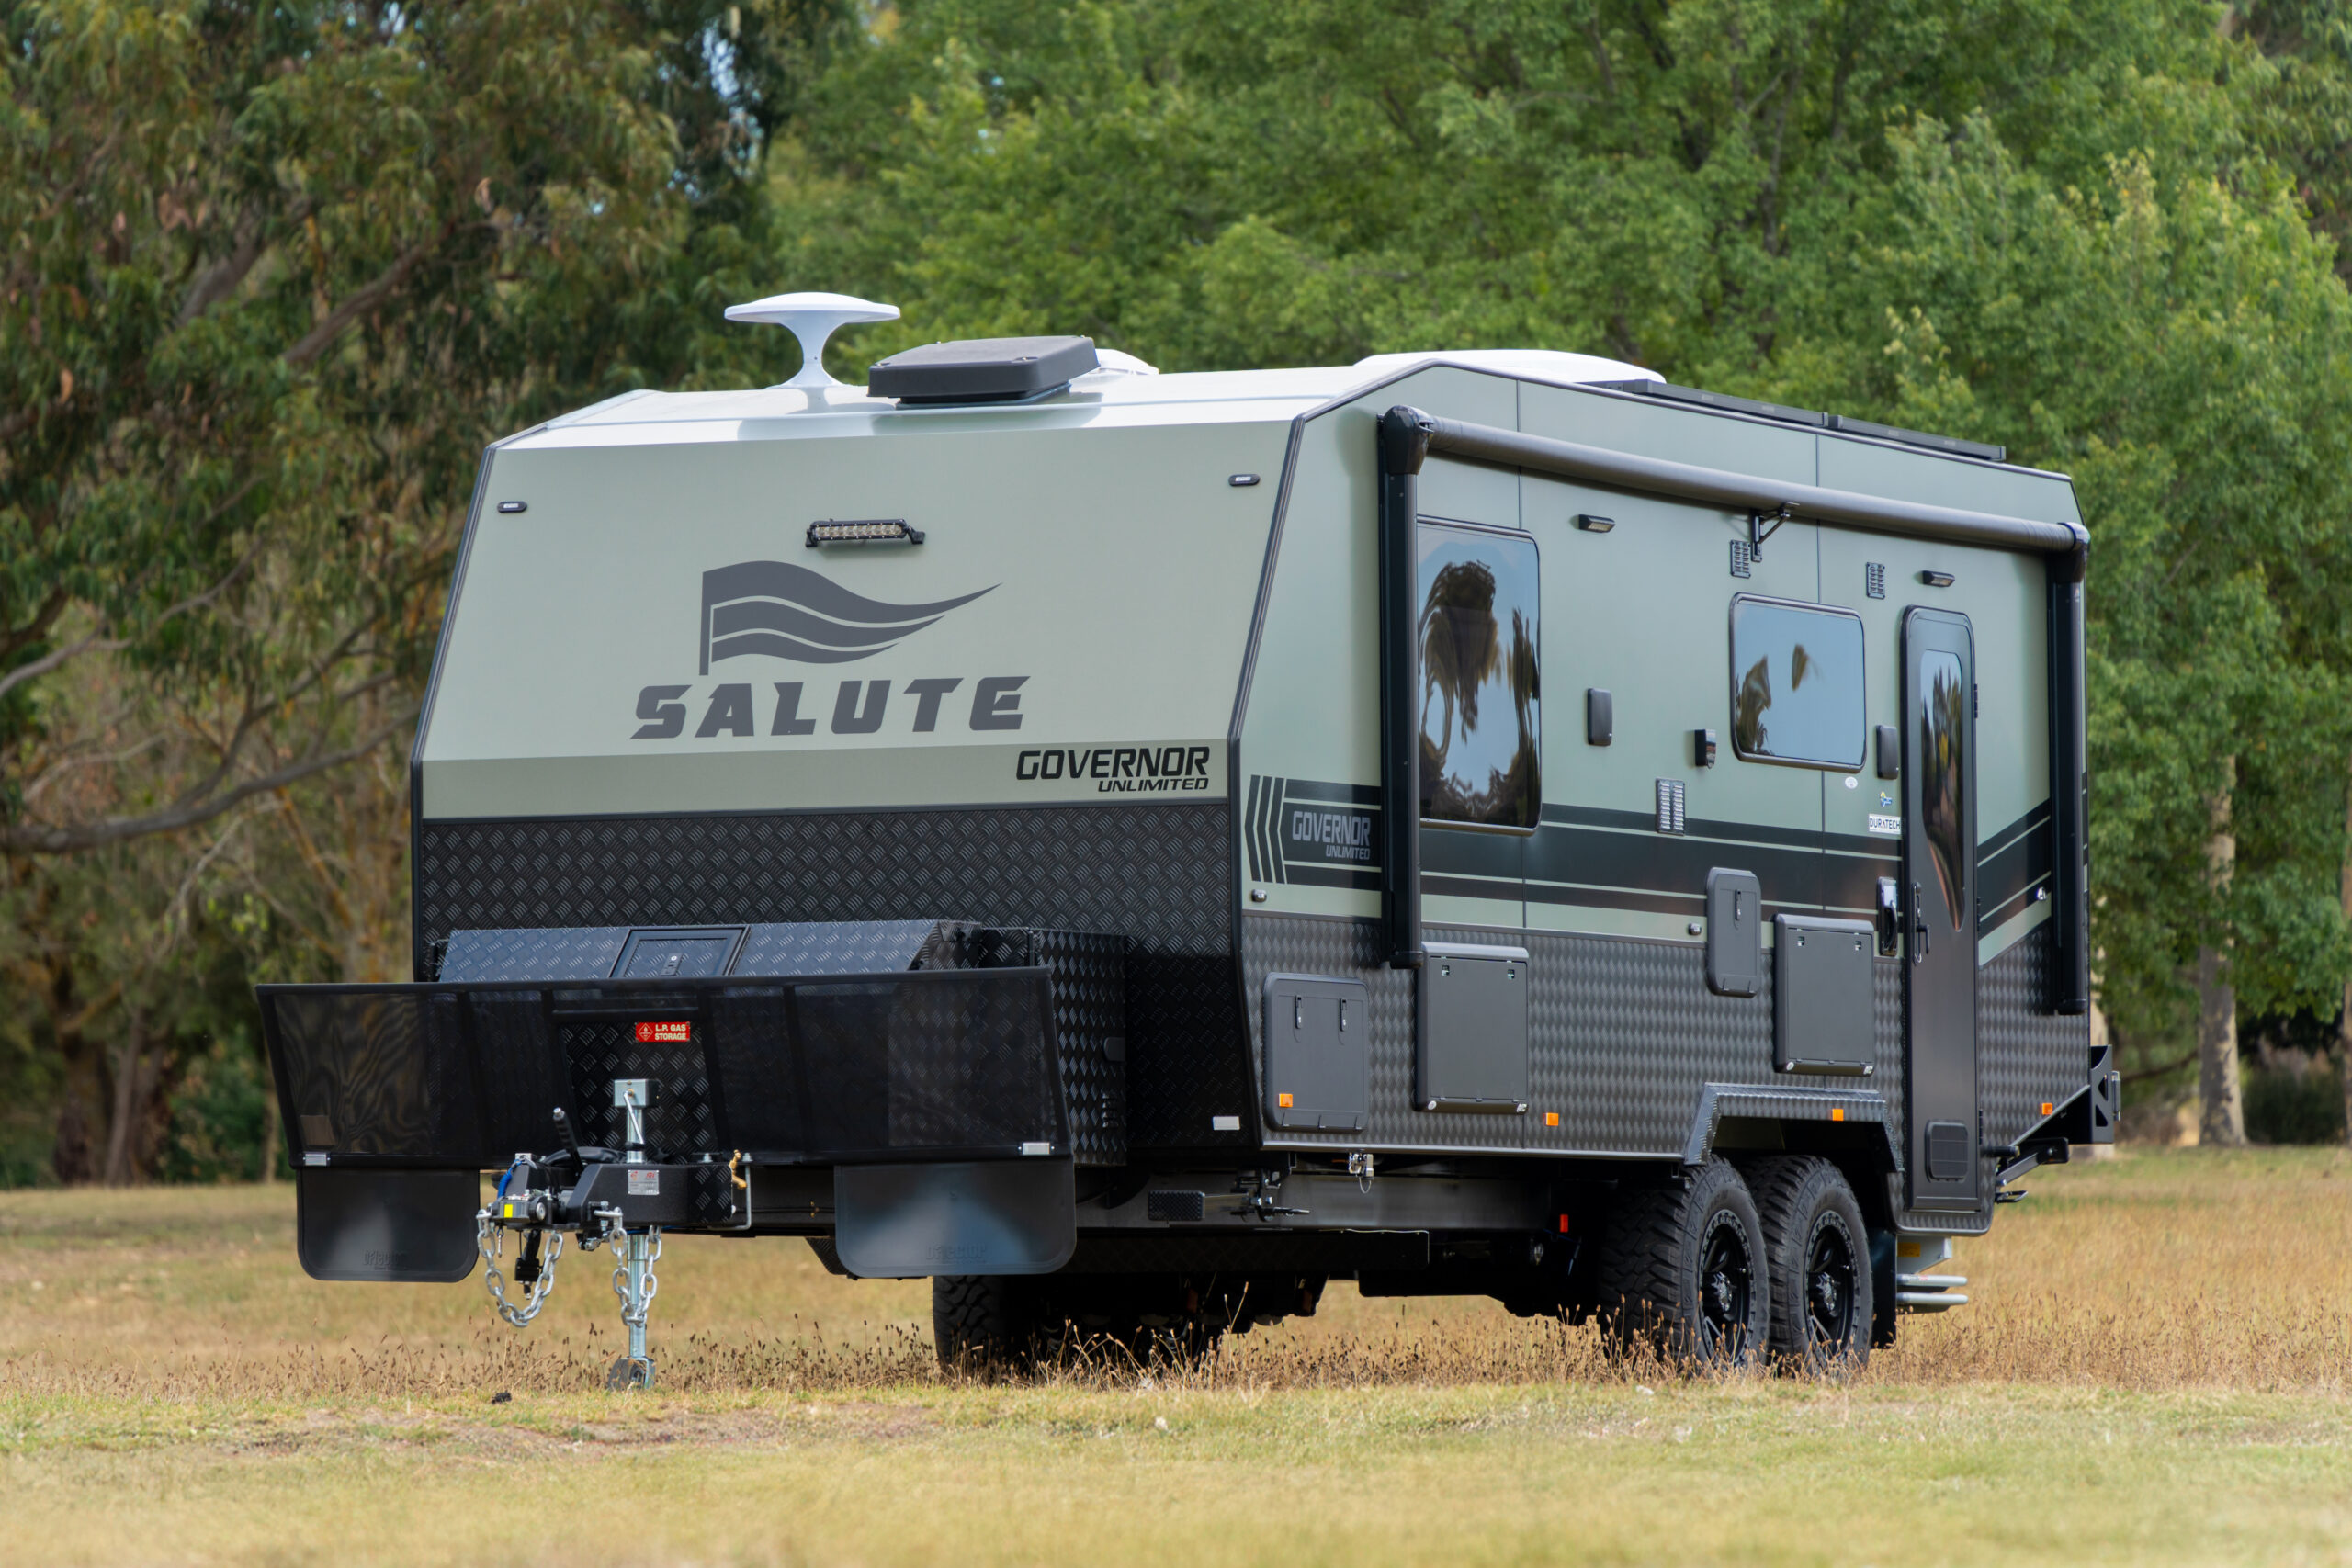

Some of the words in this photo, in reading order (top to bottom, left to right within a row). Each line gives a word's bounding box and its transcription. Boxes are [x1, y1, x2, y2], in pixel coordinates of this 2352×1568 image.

[629, 676, 1031, 739] SALUTE
[1016, 746, 1210, 780] GOVERNOR
[1098, 778, 1209, 793] UNLIMITED
[1292, 811, 1371, 846] GOVERNOR
[1869, 818, 1900, 829] DURATECH
[1326, 845, 1371, 860] UNLIMITED
